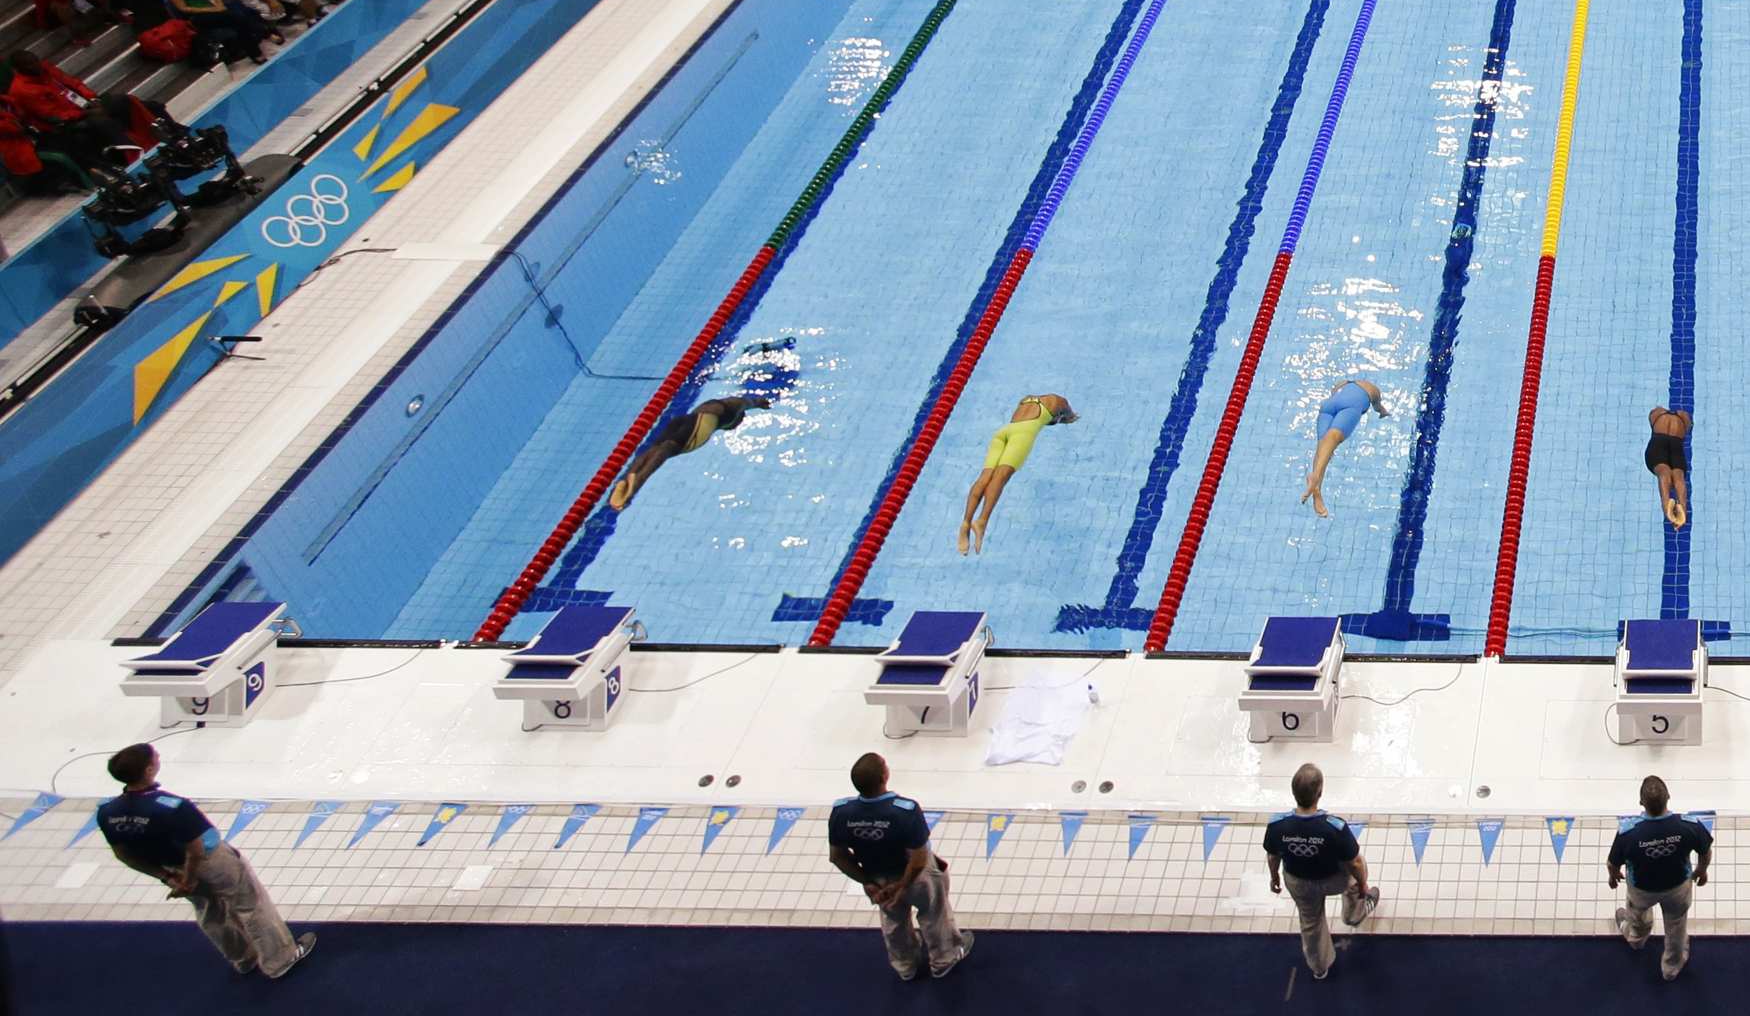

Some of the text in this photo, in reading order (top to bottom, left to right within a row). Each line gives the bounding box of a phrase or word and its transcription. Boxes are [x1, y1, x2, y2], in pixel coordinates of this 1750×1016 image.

[247, 673, 262, 691] 9
[608, 677, 619, 695] 8
[1652, 714, 1669, 734] 5
[1282, 835, 1308, 843] London
[1639, 839, 1665, 848] London
